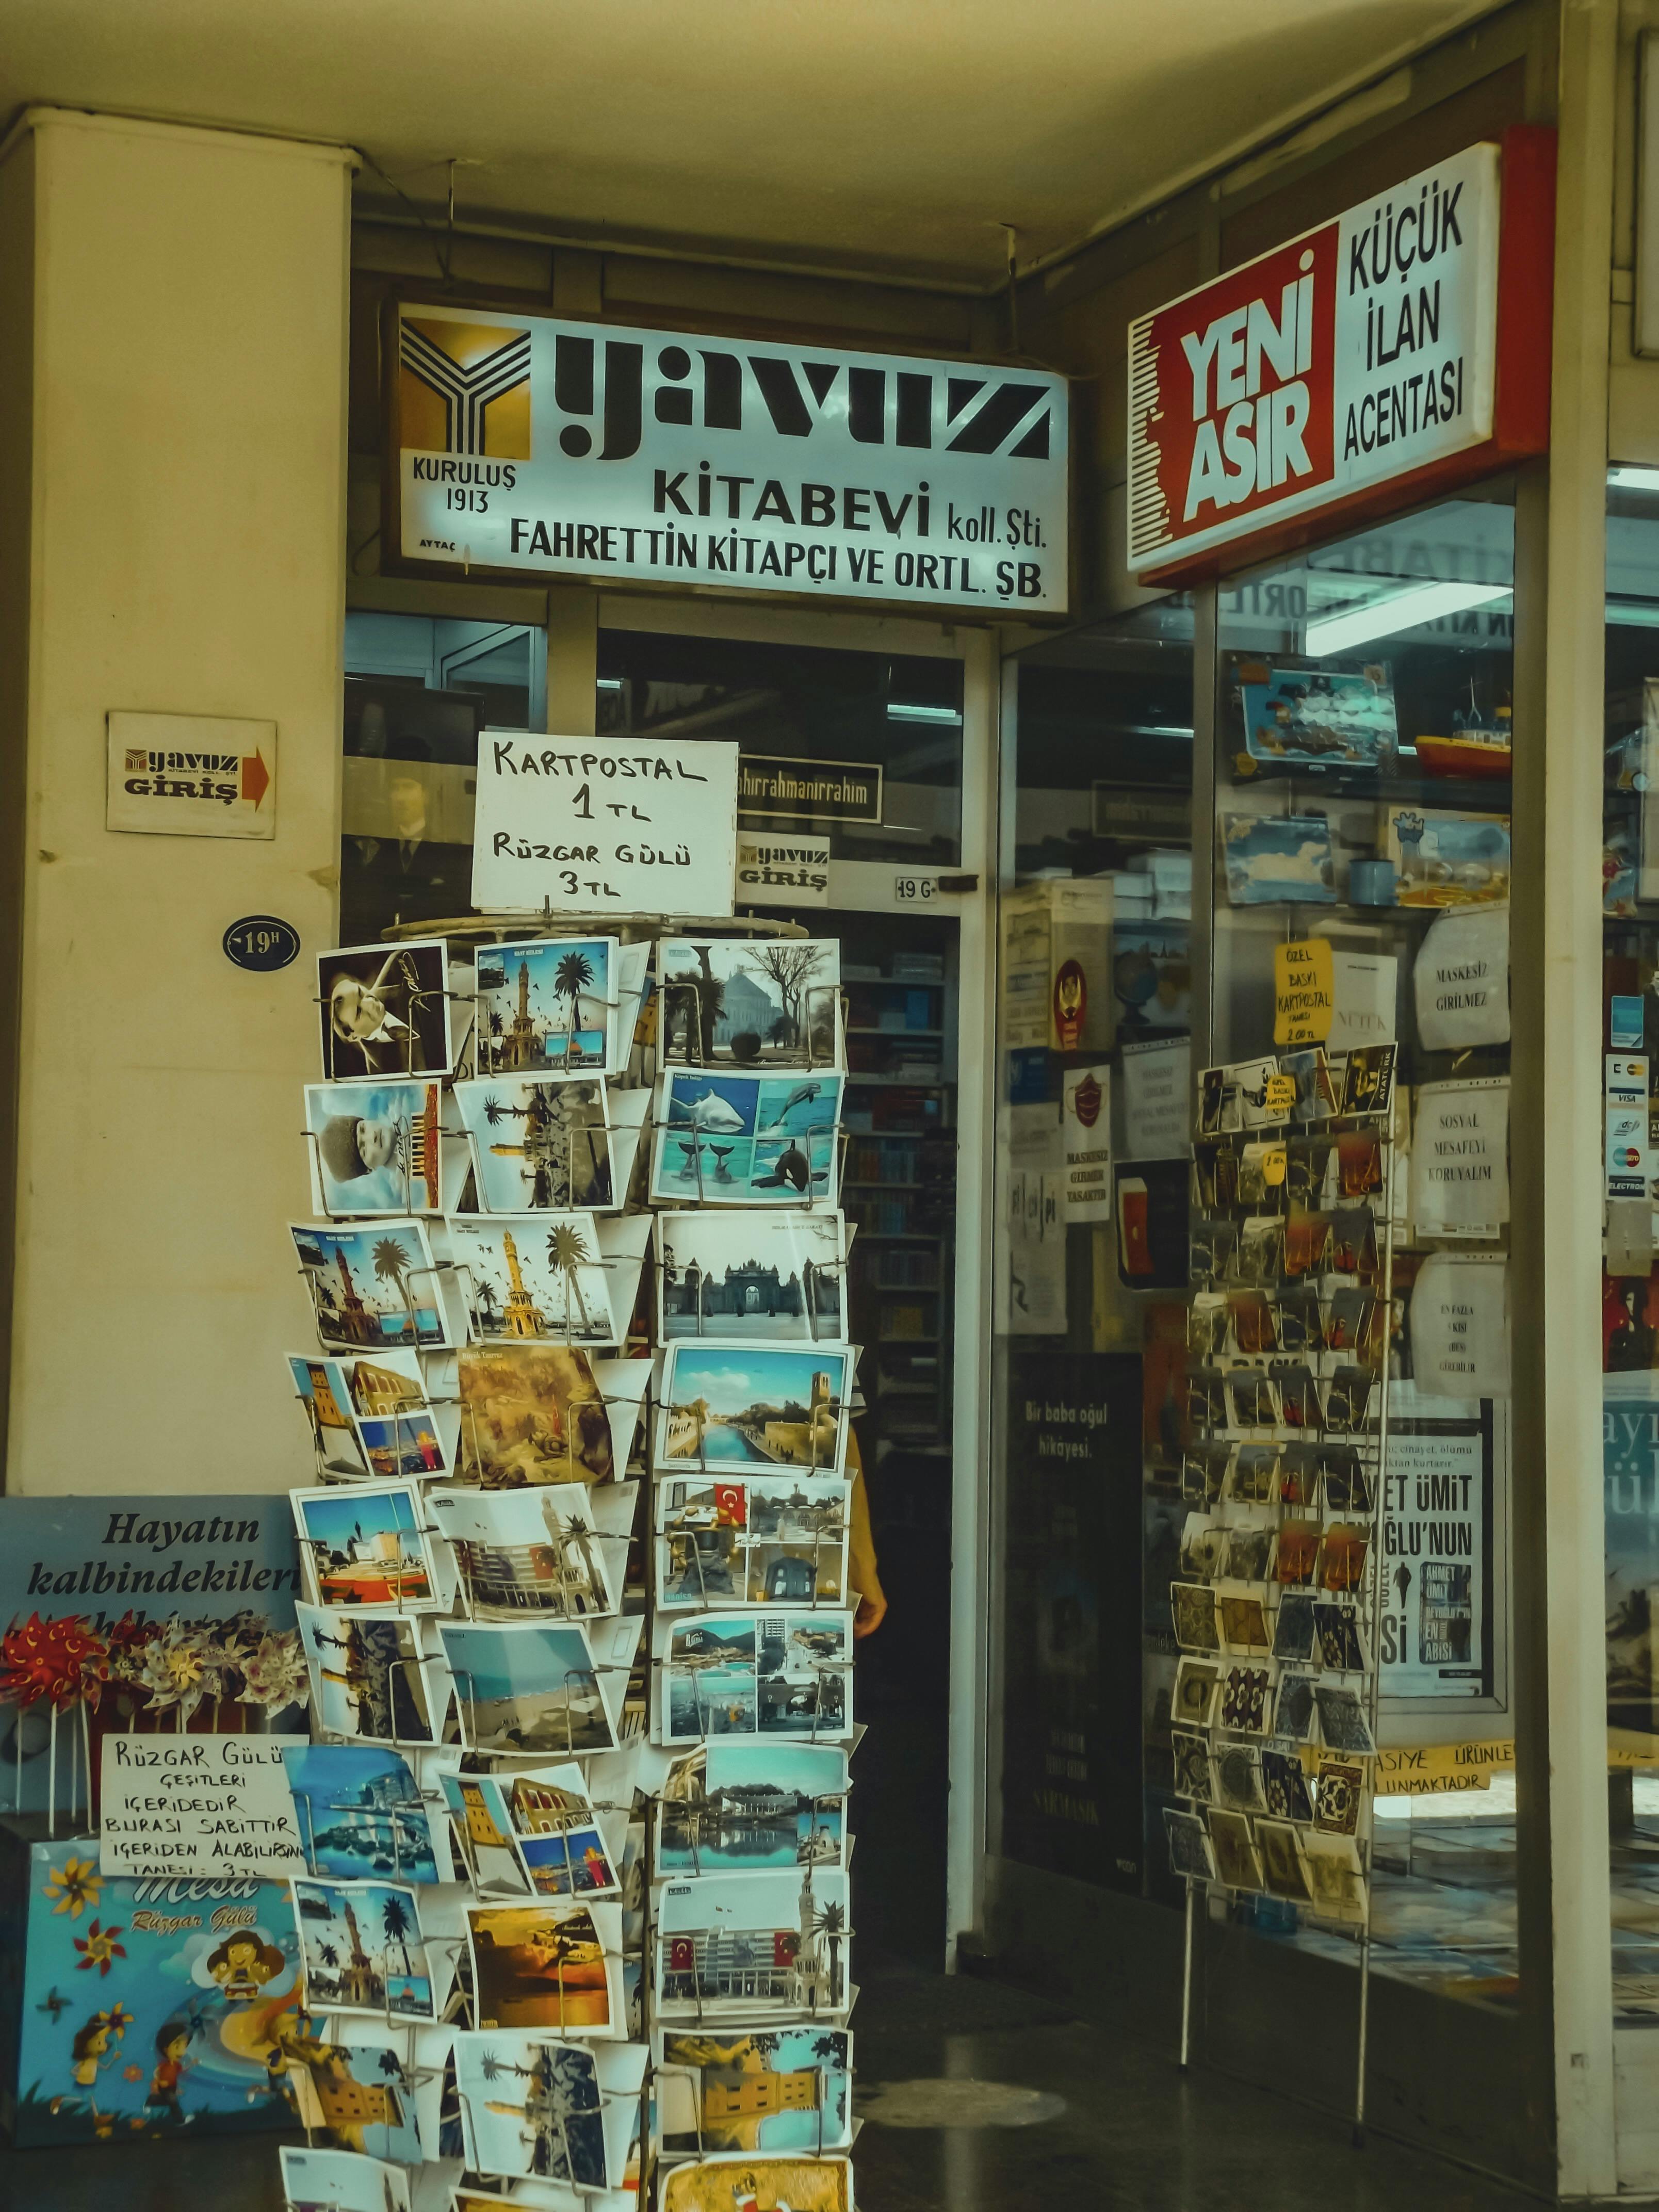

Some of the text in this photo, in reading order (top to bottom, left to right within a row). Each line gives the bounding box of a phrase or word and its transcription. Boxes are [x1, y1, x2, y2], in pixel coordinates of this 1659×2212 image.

[1349, 180, 1464, 296] KÜÇÜK
[1180, 249, 1314, 421] YENİ
[1367, 280, 1440, 371] İLAN
[555, 334, 1051, 461] yavuz
[1344, 356, 1463, 461] ACENTASI
[1183, 380, 1313, 522] ASIR
[413, 457, 516, 490] KURULUŞ
[446, 489, 489, 514] 1913
[653, 460, 1048, 549] KİTABEVİ koll. Şti.
[419, 538, 456, 553] AYTAÇ
[510, 517, 697, 570] FAHRETTİN
[708, 527, 837, 584] KİTAPÇI
[849, 547, 884, 584] VE
[894, 552, 987, 594] ORTL.
[494, 741, 708, 782] KARTPOSTAL
[124, 775, 238, 805] GİRİŞ
[572, 783, 652, 822] 1 TL
[493, 832, 691, 866] RÜZGAR GÜLÜ
[739, 867, 827, 892] GİRİŞ
[900, 881, 930, 898] 19 G
[1288, 971, 1316, 987] BASKI
[1437, 960, 1488, 983] MASKESİZ
[1278, 991, 1330, 1013] KARTPOSTAL
[1619, 1094, 1636, 1102] VISA
[1440, 1113, 1479, 1129] SOSYAL
[1435, 1136, 1486, 1156] MESAFEYİ
[1428, 1165, 1491, 1181] KORUYALIM
[1452, 1305, 1474, 1315] FAZLA
[1026, 1400, 1108, 1429] Bir baba oğul
[1417, 1474, 1472, 1511] ÜMİT
[102, 1513, 260, 1552] Hayatın
[27, 1559, 300, 1595] kalbindekileri
[1426, 1565, 1455, 1582] AHMET
[1425, 1622, 1438, 1640] EN
[1425, 1642, 1452, 1661] ABİSİ
[116, 1741, 283, 1768] RÜZGAR GÜLÜ
[1454, 1744, 1515, 1765] ÜRÜNLE
[160, 1773, 246, 1790] ÇEŞİTLERİ
[124, 1794, 247, 1813] İÇERİDEDİR
[105, 1815, 297, 1836] BURASI SABİTTİR
[110, 1840, 197, 1859] İÇERİDEN
[132, 1905, 257, 1936] Rüzgar Gülü
